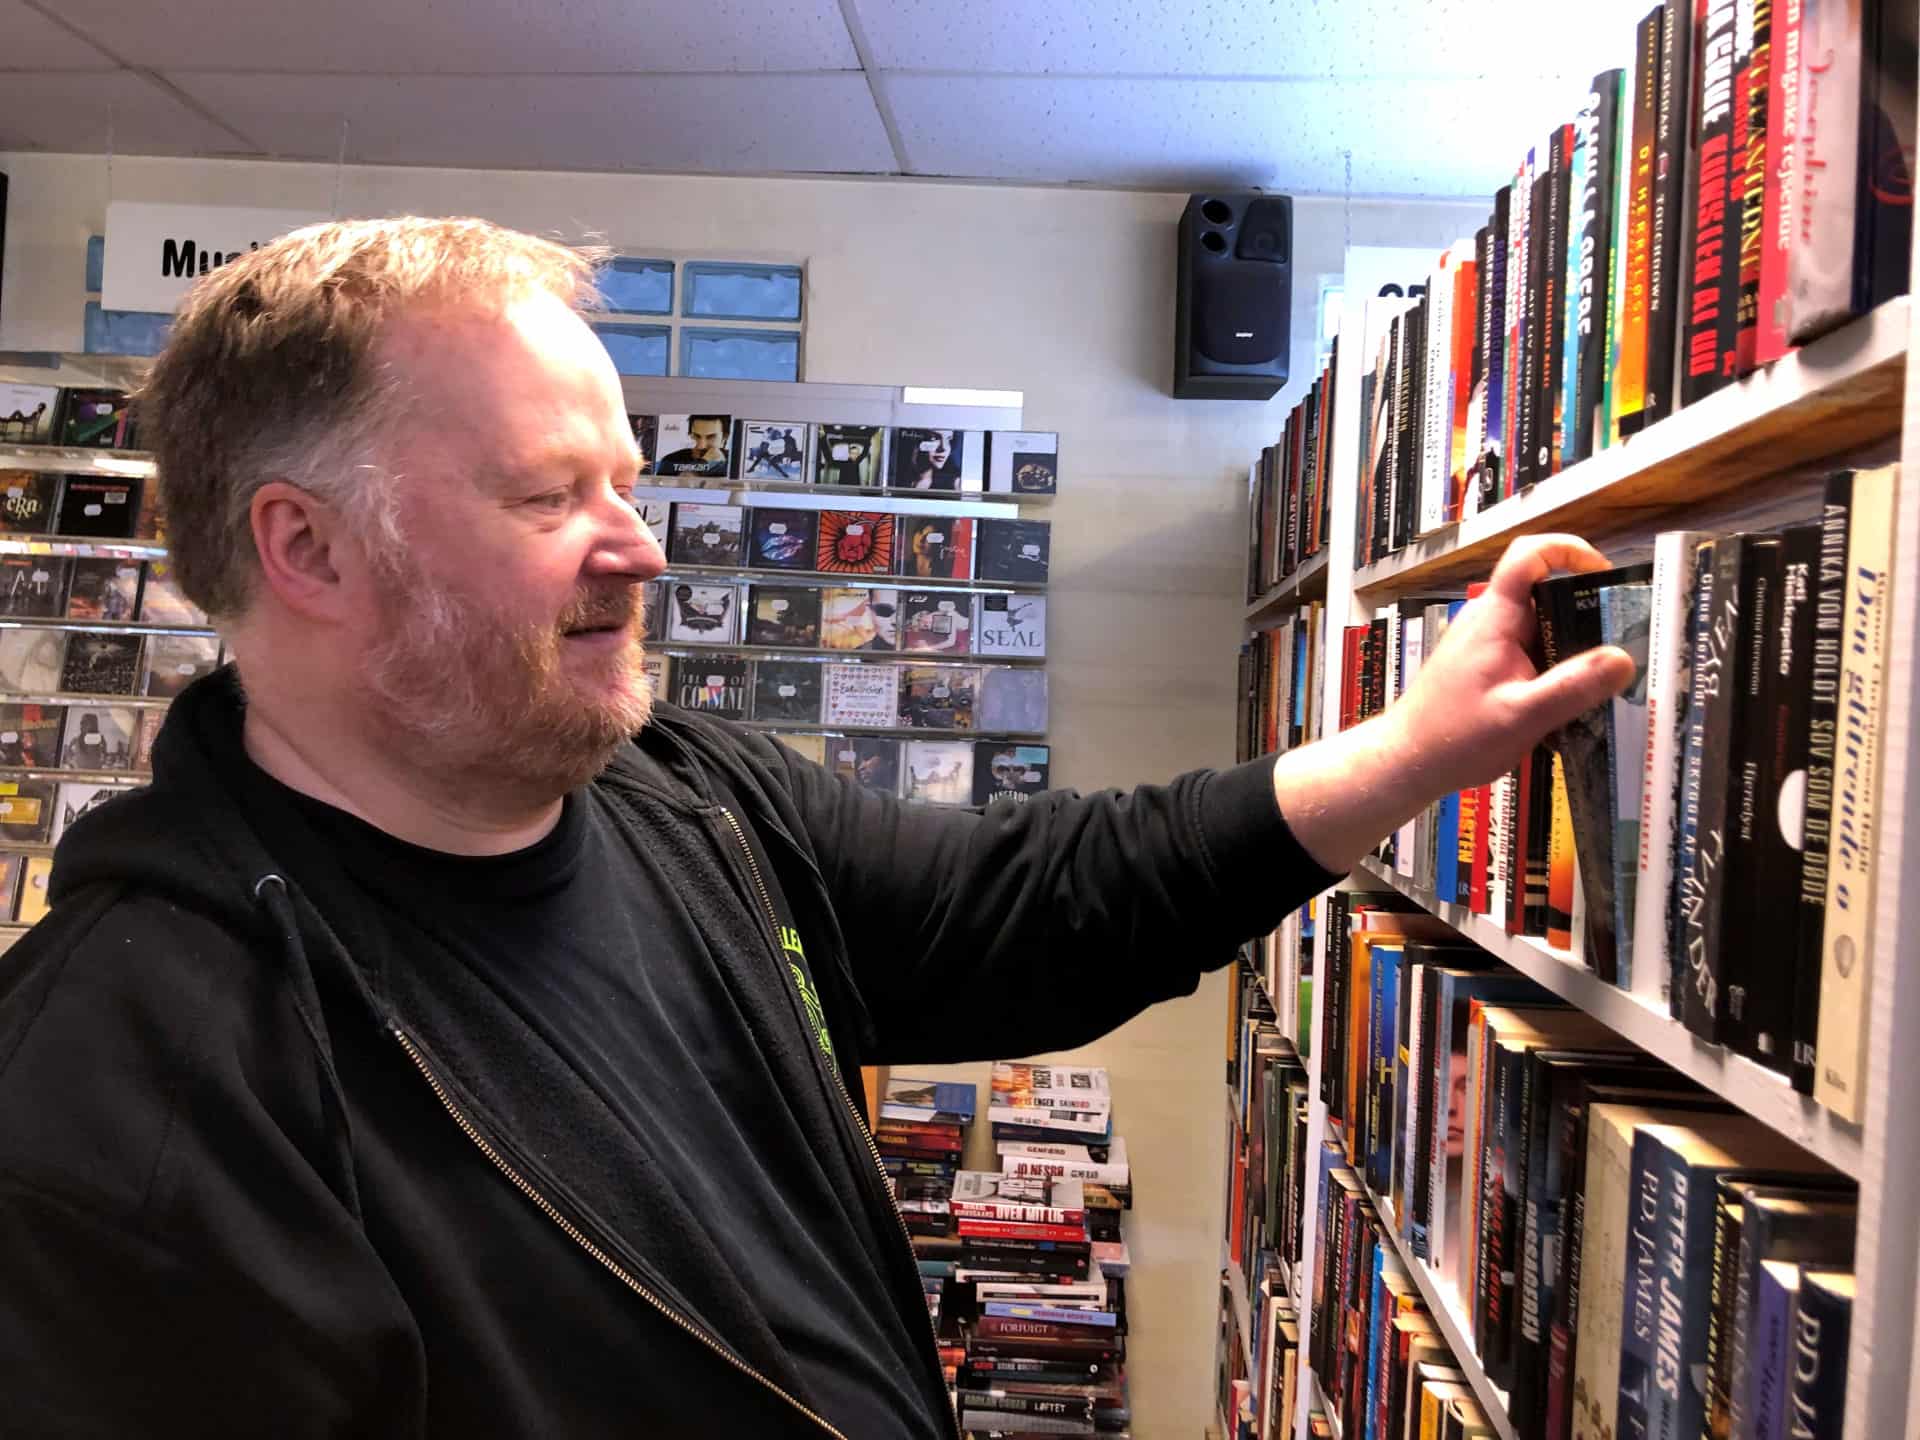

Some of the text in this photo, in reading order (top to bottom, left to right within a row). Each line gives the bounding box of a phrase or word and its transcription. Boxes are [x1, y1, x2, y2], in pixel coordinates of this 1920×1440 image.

[1659, 52, 1672, 138] GRISHAM
[1781, 29, 1800, 136] magiske
[1776, 144, 1795, 250] rejsende
[1483, 234, 1494, 289] ROBERT
[1651, 193, 1665, 311] TOUCHDOWN
[1480, 292, 1492, 360] GODDARD
[1700, 573, 1713, 622] Claus
[1779, 564, 1797, 676] Hiekkapelto
[1794, 563, 1809, 603] Kati
[1854, 566, 1878, 655] Den
[983, 629, 1042, 648] SEAL
[1691, 724, 1704, 746] EN
[1801, 504, 1847, 907] ANNIKA VON HOLDT SOV SOM DE DØDE
[1687, 757, 1702, 826] SKYGGE
[1741, 761, 1758, 841] Hjertelyst
[1641, 793, 1651, 871] VILLETTE
[1685, 834, 1698, 855] AF
[996, 1205, 1022, 1220] OVER
[1025, 1207, 1045, 1222] MIT
[1521, 1199, 1541, 1345] PASSAGEREN
[1633, 1168, 1661, 1343] P.D. JAMES
[1655, 1168, 1689, 1400] PETER JAMES
[1034, 1401, 1066, 1413] LØFTET
